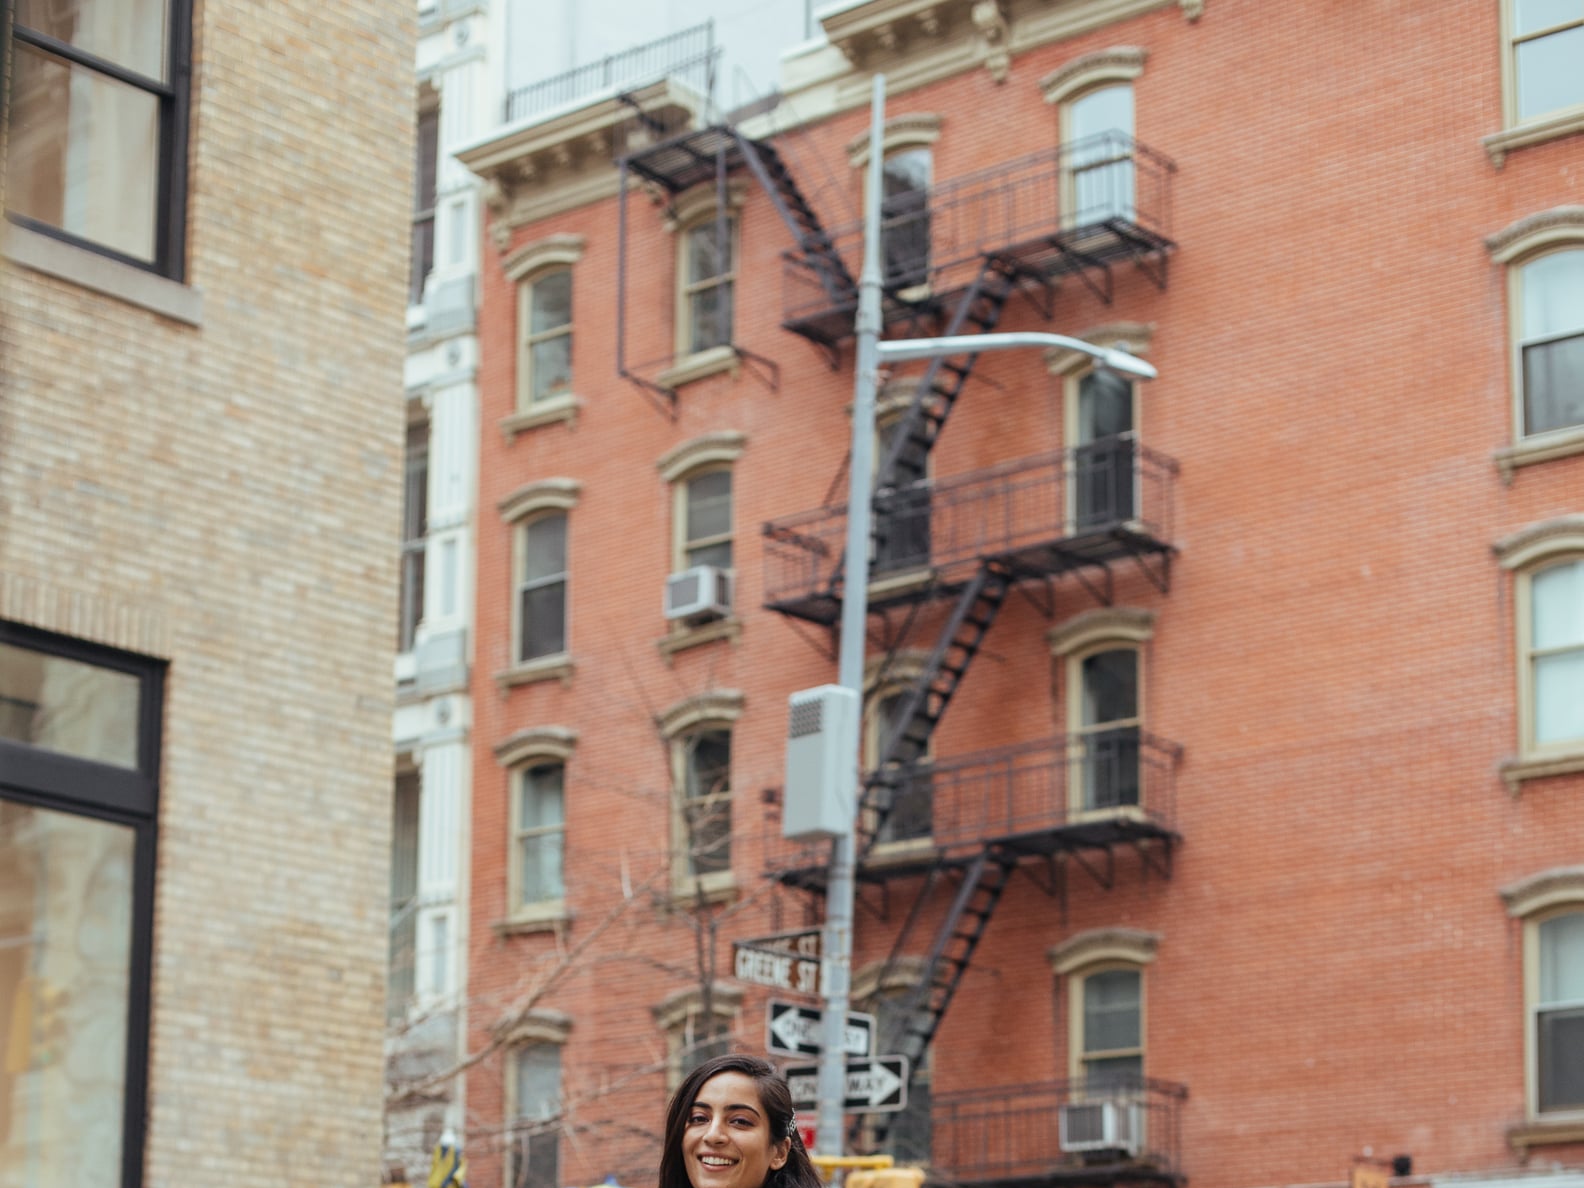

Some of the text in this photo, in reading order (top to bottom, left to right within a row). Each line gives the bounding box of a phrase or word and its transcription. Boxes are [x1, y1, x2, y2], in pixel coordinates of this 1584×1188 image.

[736, 947, 817, 993] GREENE ST
[848, 1076, 884, 1092] WAY
